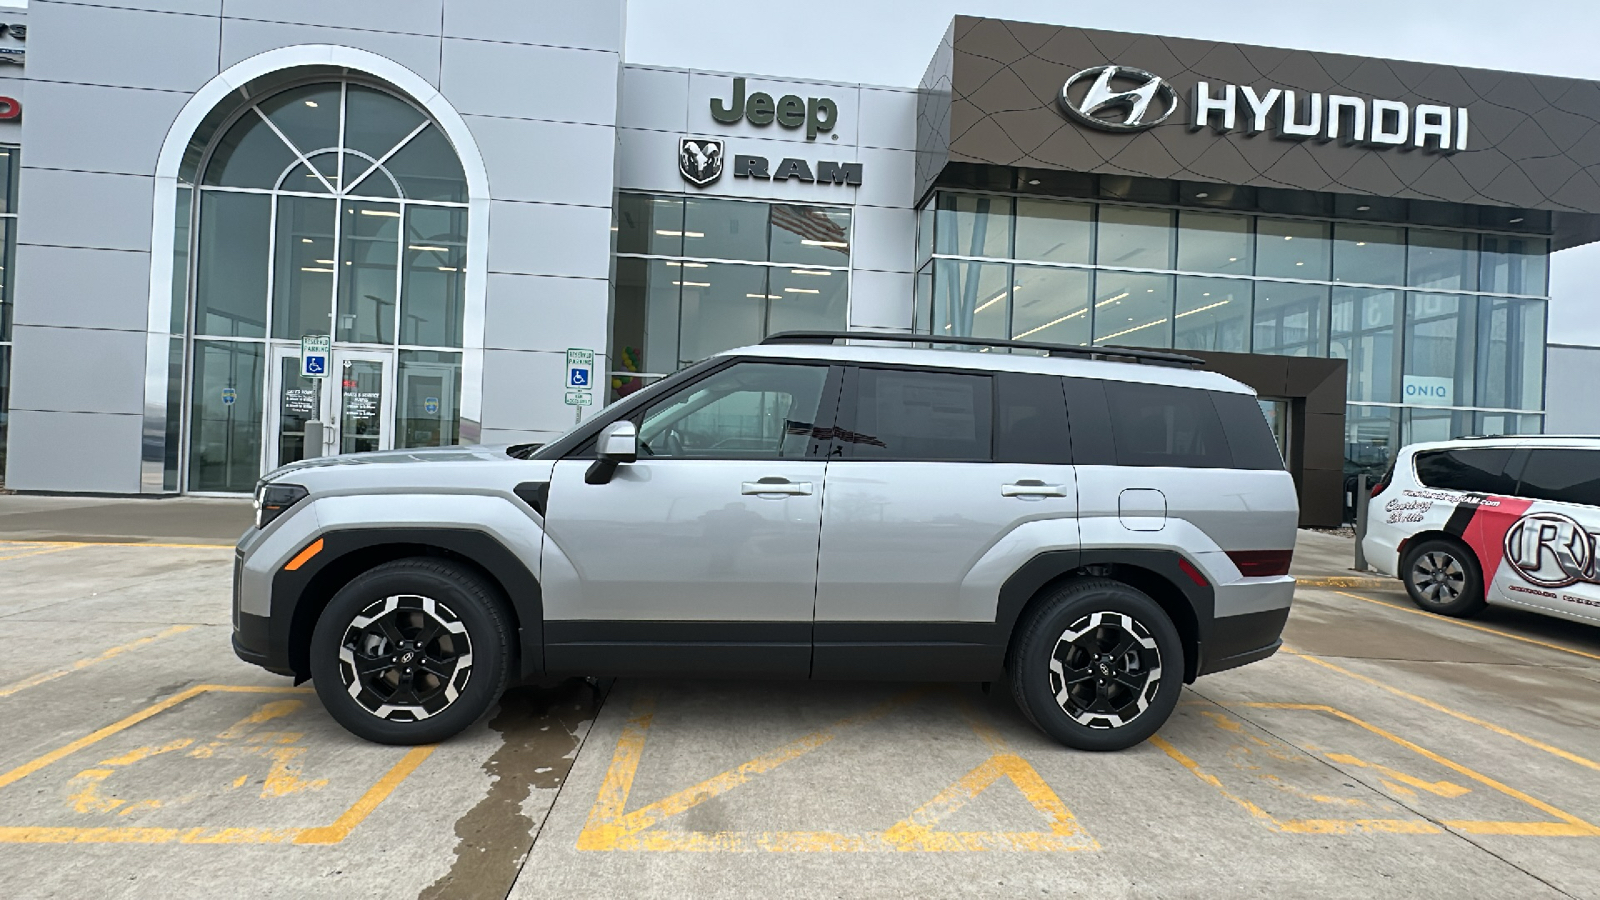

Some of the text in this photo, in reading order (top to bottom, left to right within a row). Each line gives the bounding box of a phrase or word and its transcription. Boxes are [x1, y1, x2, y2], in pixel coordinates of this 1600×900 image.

[710, 77, 838, 140] Jeep
[1192, 81, 1468, 152] HYUNDAI
[733, 154, 863, 185] RAM
[1406, 384, 1446, 397] ONIQ
